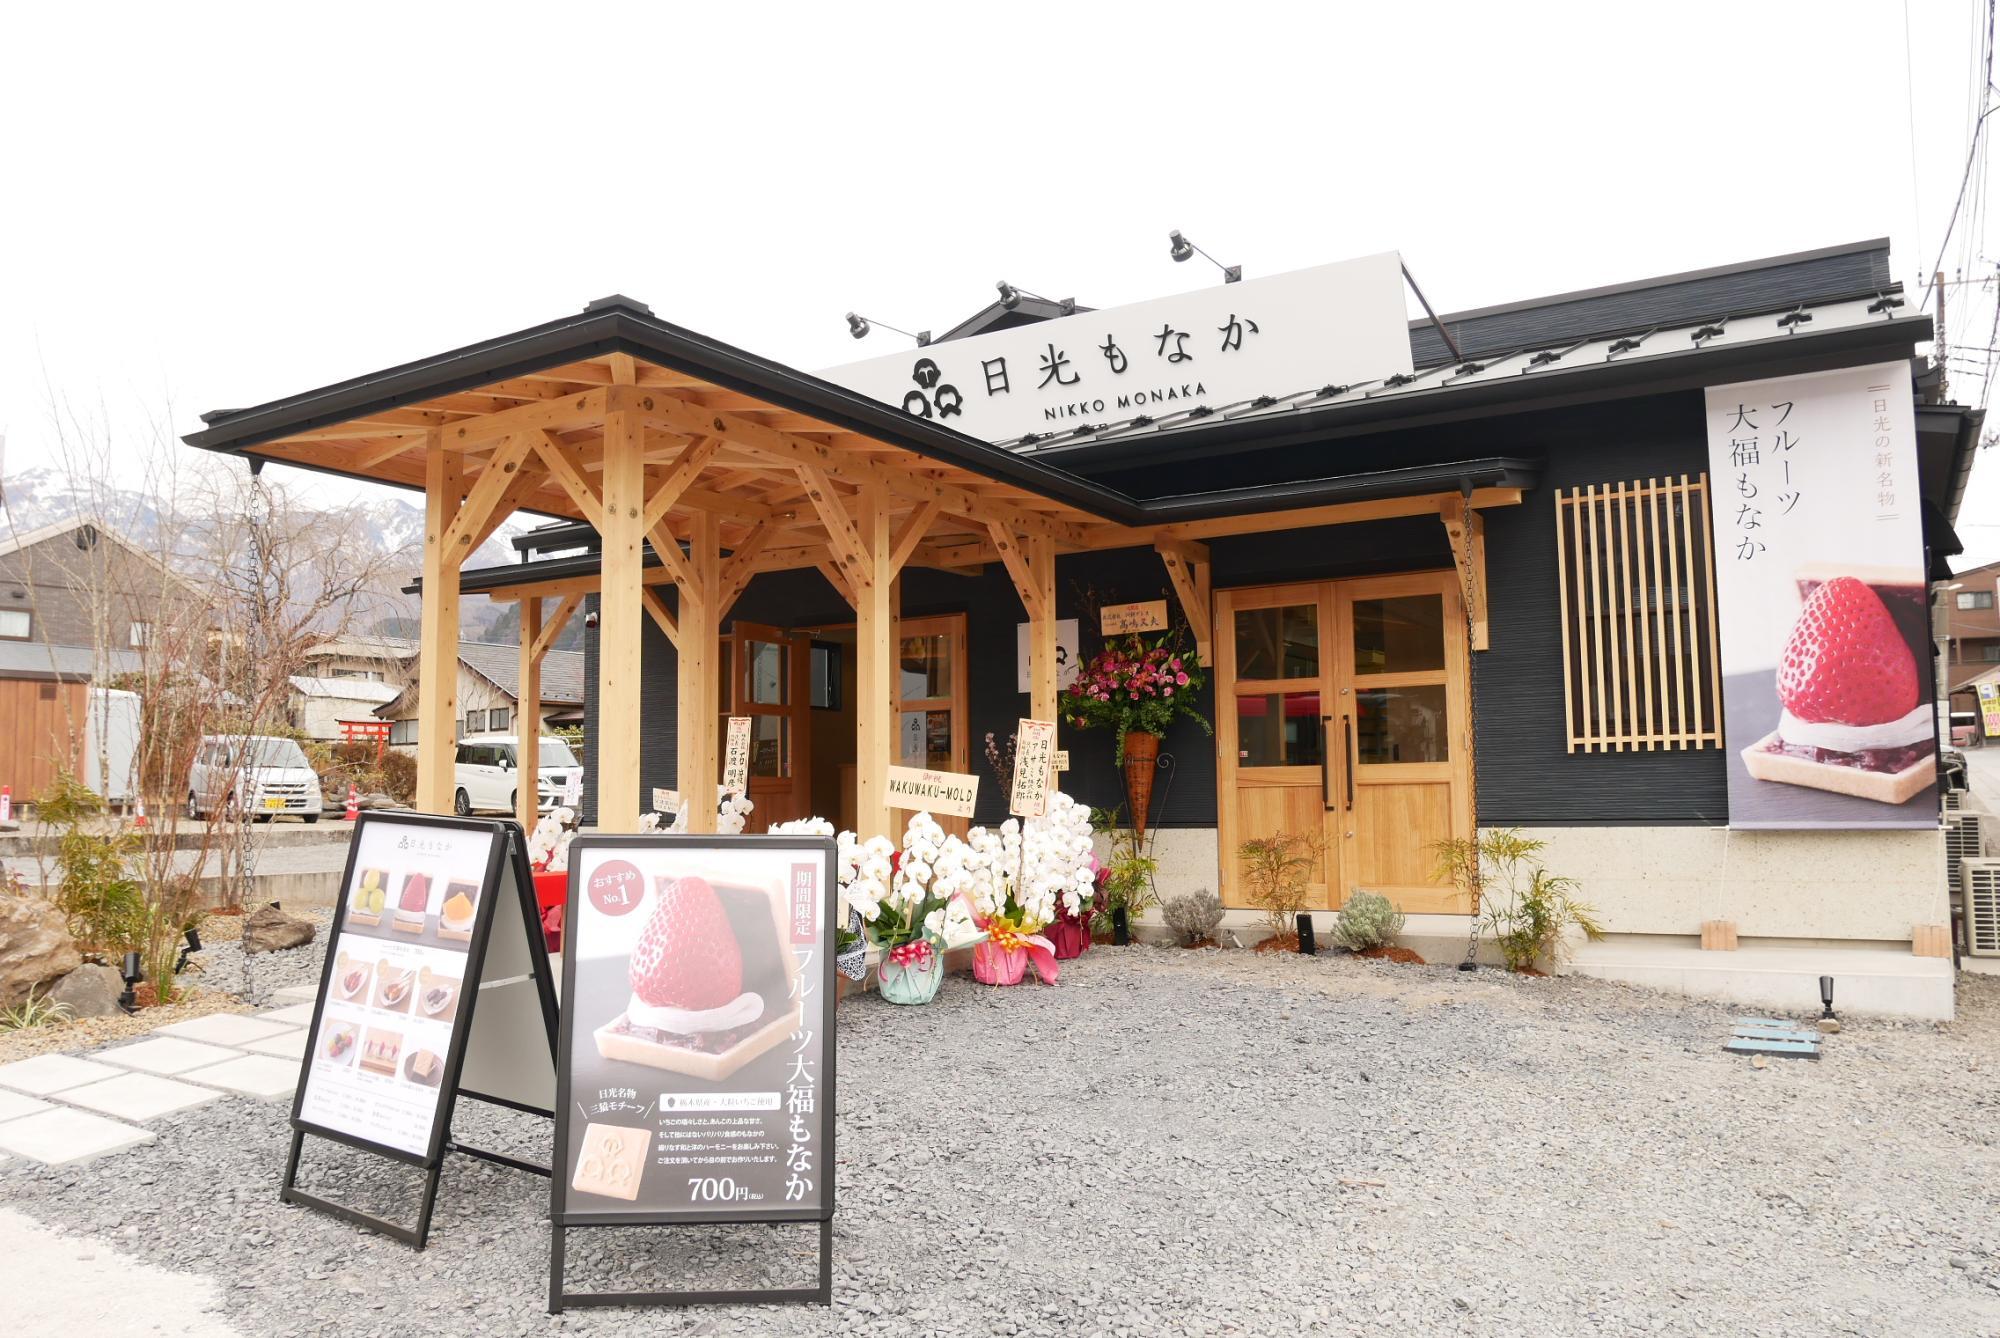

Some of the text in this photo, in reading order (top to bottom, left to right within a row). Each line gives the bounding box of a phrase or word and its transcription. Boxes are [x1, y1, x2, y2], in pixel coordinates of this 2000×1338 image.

[980, 313, 1260, 397] 日光もなか
[1044, 381, 1207, 420] NIKKO MONAKA
[1725, 403, 1767, 561] 大福もなか
[1770, 400, 1801, 517] フルーツ
[1873, 398, 1896, 508] 日光の新名物
[889, 779, 973, 803] WAKUWAKU-MOLD
[593, 870, 636, 889] おすすめ
[794, 870, 813, 937] 期間限定
[599, 1087, 638, 1100] 日光名物
[785, 949, 816, 1202] フルーツ大福もなか
